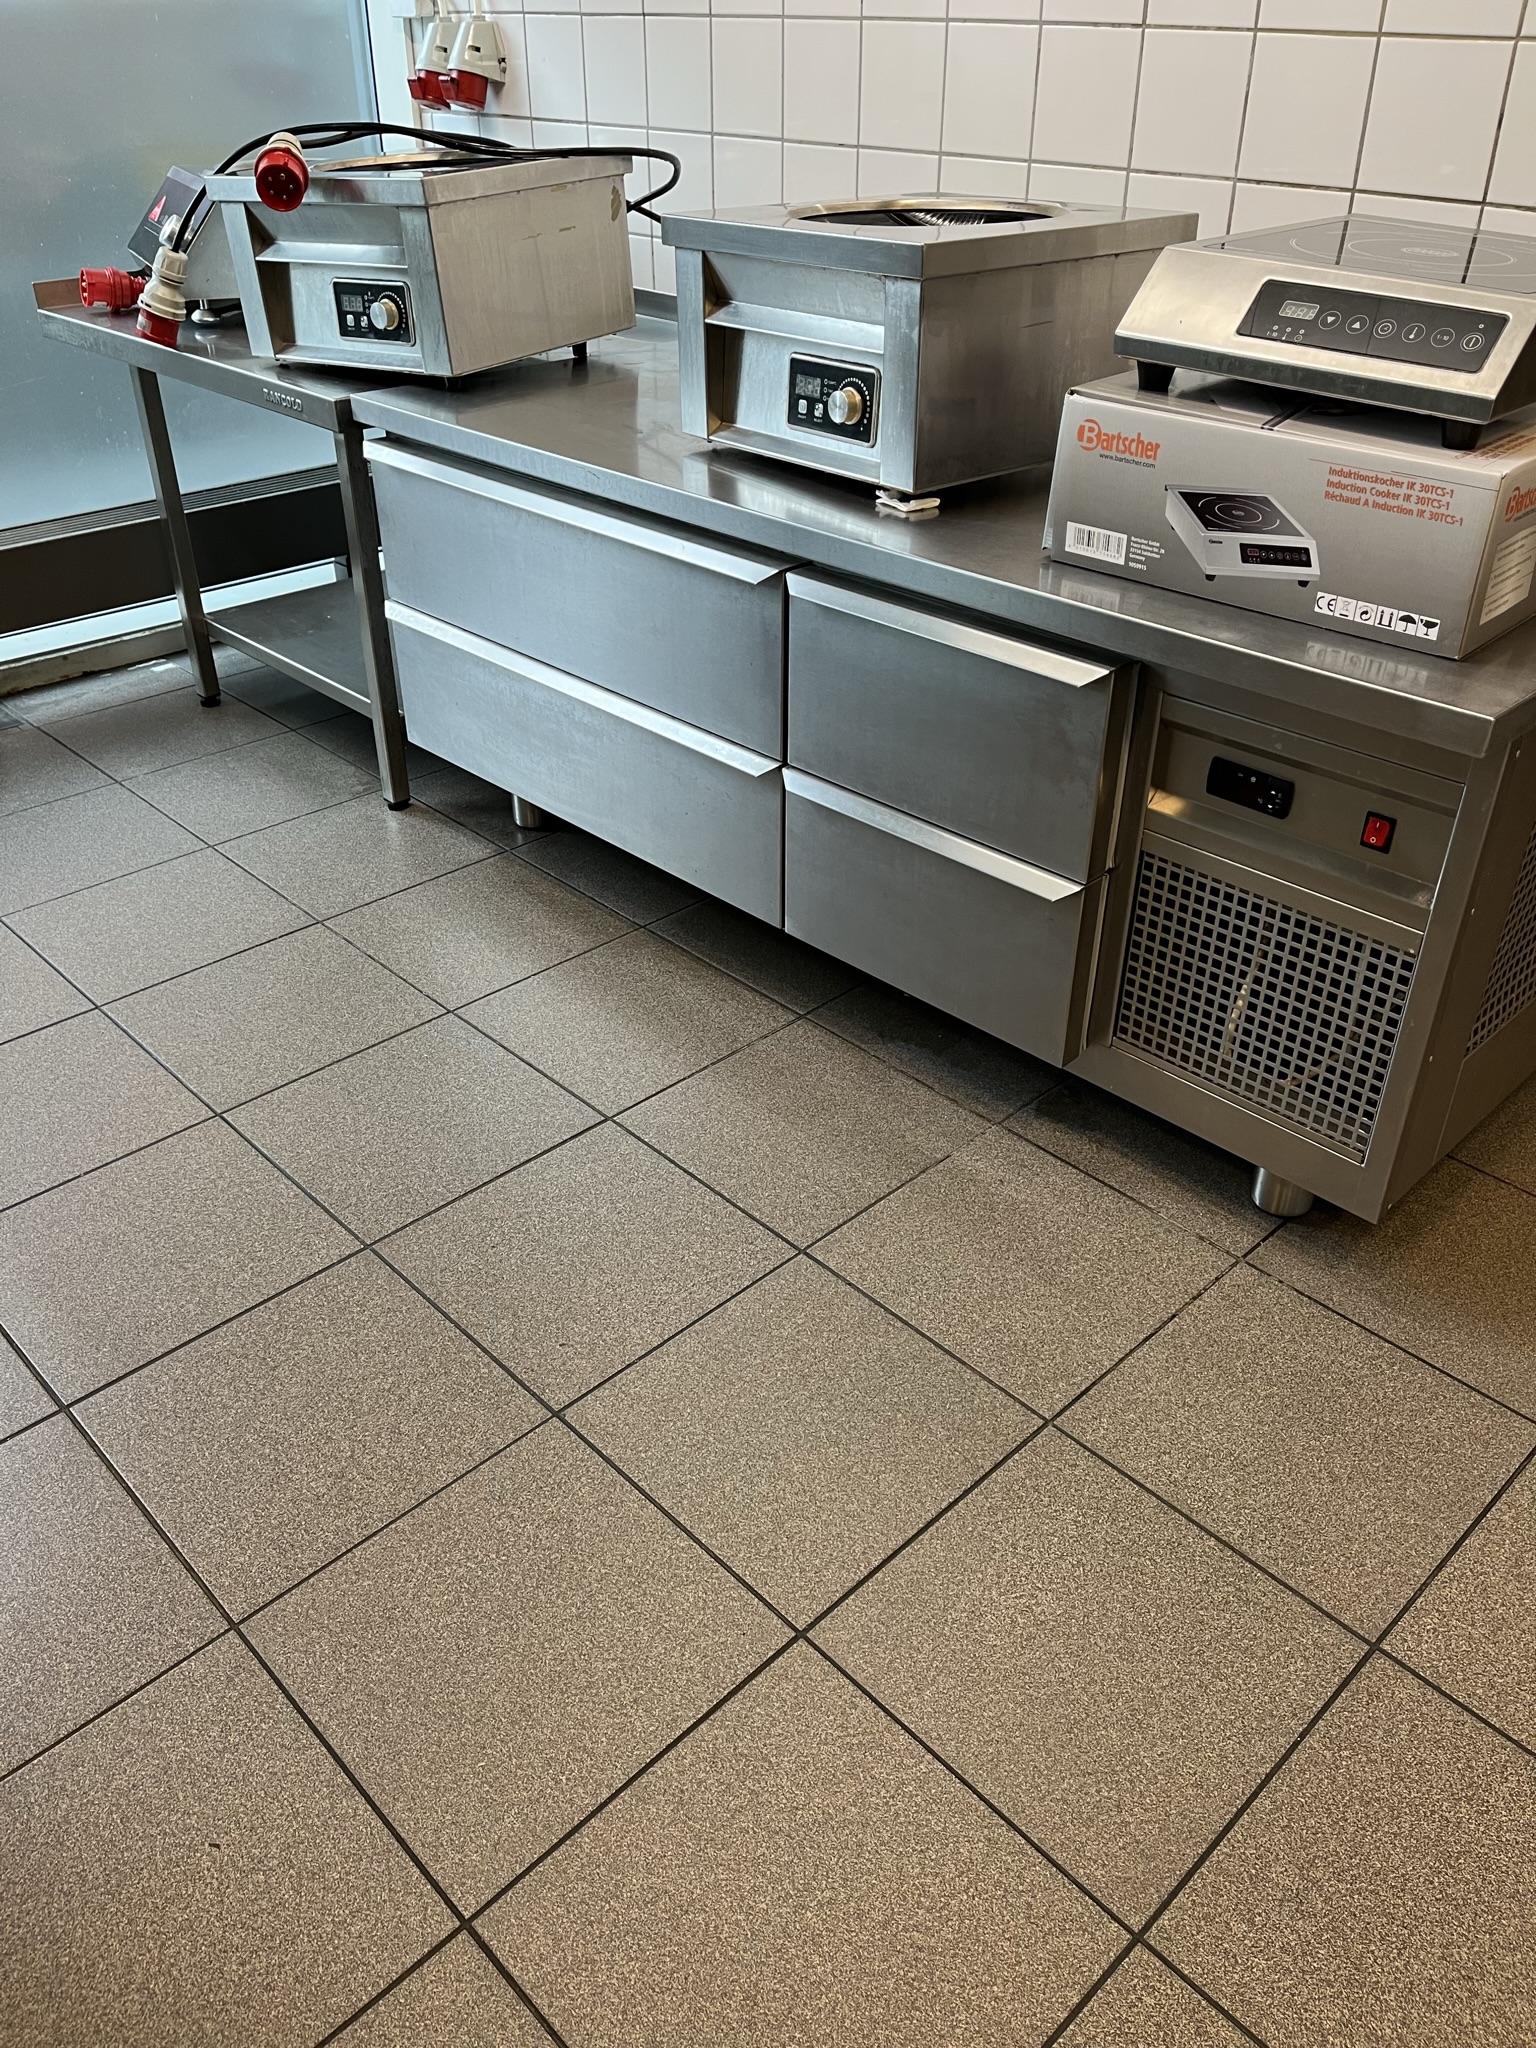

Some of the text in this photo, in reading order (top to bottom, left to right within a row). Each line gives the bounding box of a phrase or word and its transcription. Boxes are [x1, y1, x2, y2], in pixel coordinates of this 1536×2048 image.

[1077, 418, 1161, 461] Bartscher
[1099, 453, 1156, 469] www.bartscher.com
[1326, 478, 1451, 511] Induction Cooker IK 30TCS-1
[1328, 466, 1455, 499] Induktionskocher IK 30TCS-1
[1324, 490, 1361, 506] Réchaud
[1372, 500, 1414, 517] Induction
[1416, 508, 1427, 519] IK
[1427, 510, 1464, 527] 30TCS-1
